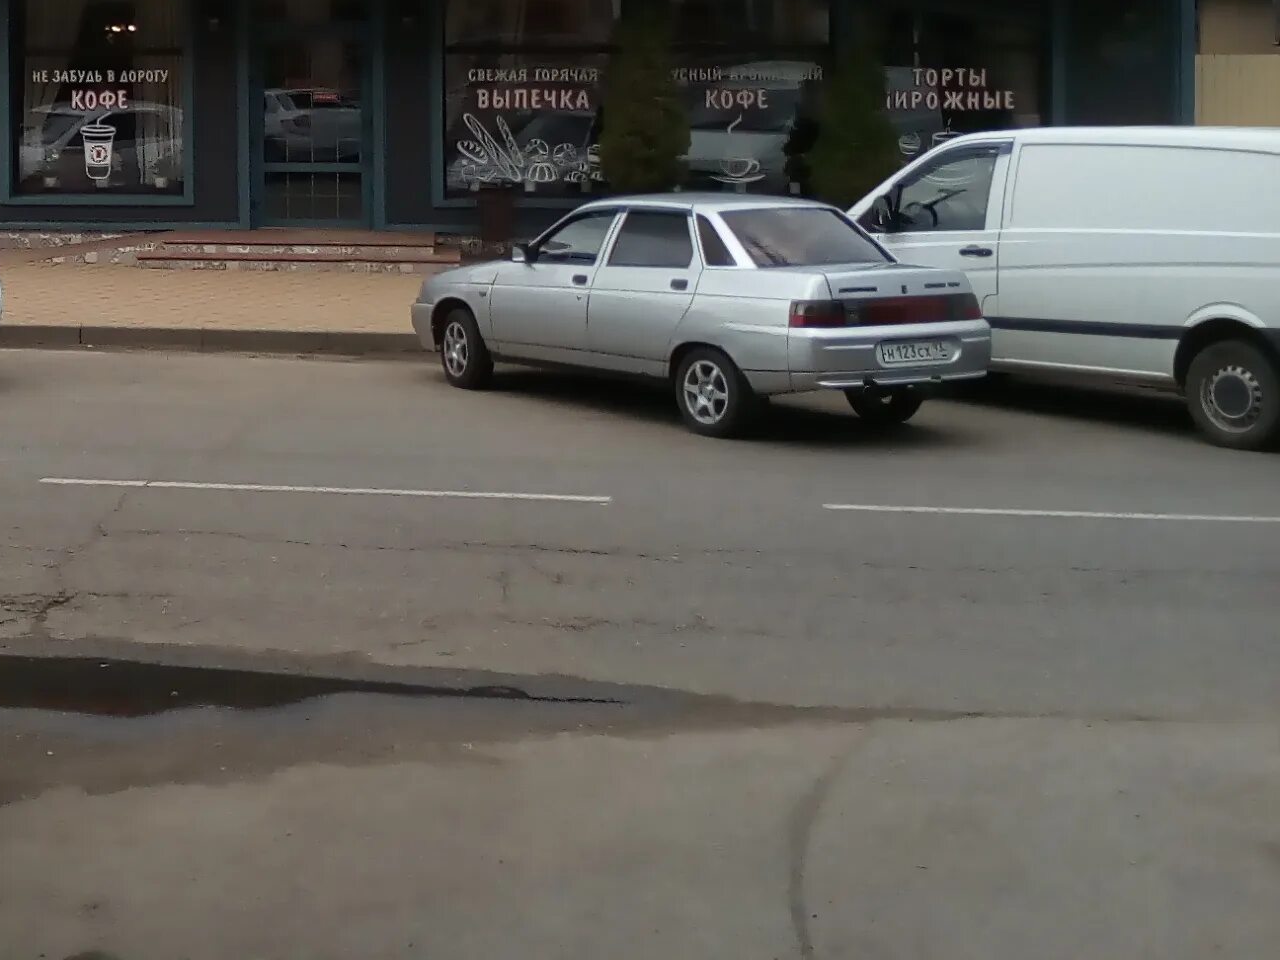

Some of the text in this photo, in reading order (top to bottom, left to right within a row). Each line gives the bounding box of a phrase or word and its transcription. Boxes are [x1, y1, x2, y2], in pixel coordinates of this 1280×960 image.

[32, 69, 169, 83] НЕ ЗАБУДЬ В ДОРОГУ
[468, 68, 599, 82] СВЕЖАЯ ГОРЯЧАЯ
[913, 68, 987, 87] ТОРТЫ
[71, 90, 129, 110] КОФЕ
[476, 89, 590, 110] ВЫПЕЧКА
[705, 88, 769, 110] КОФЕ
